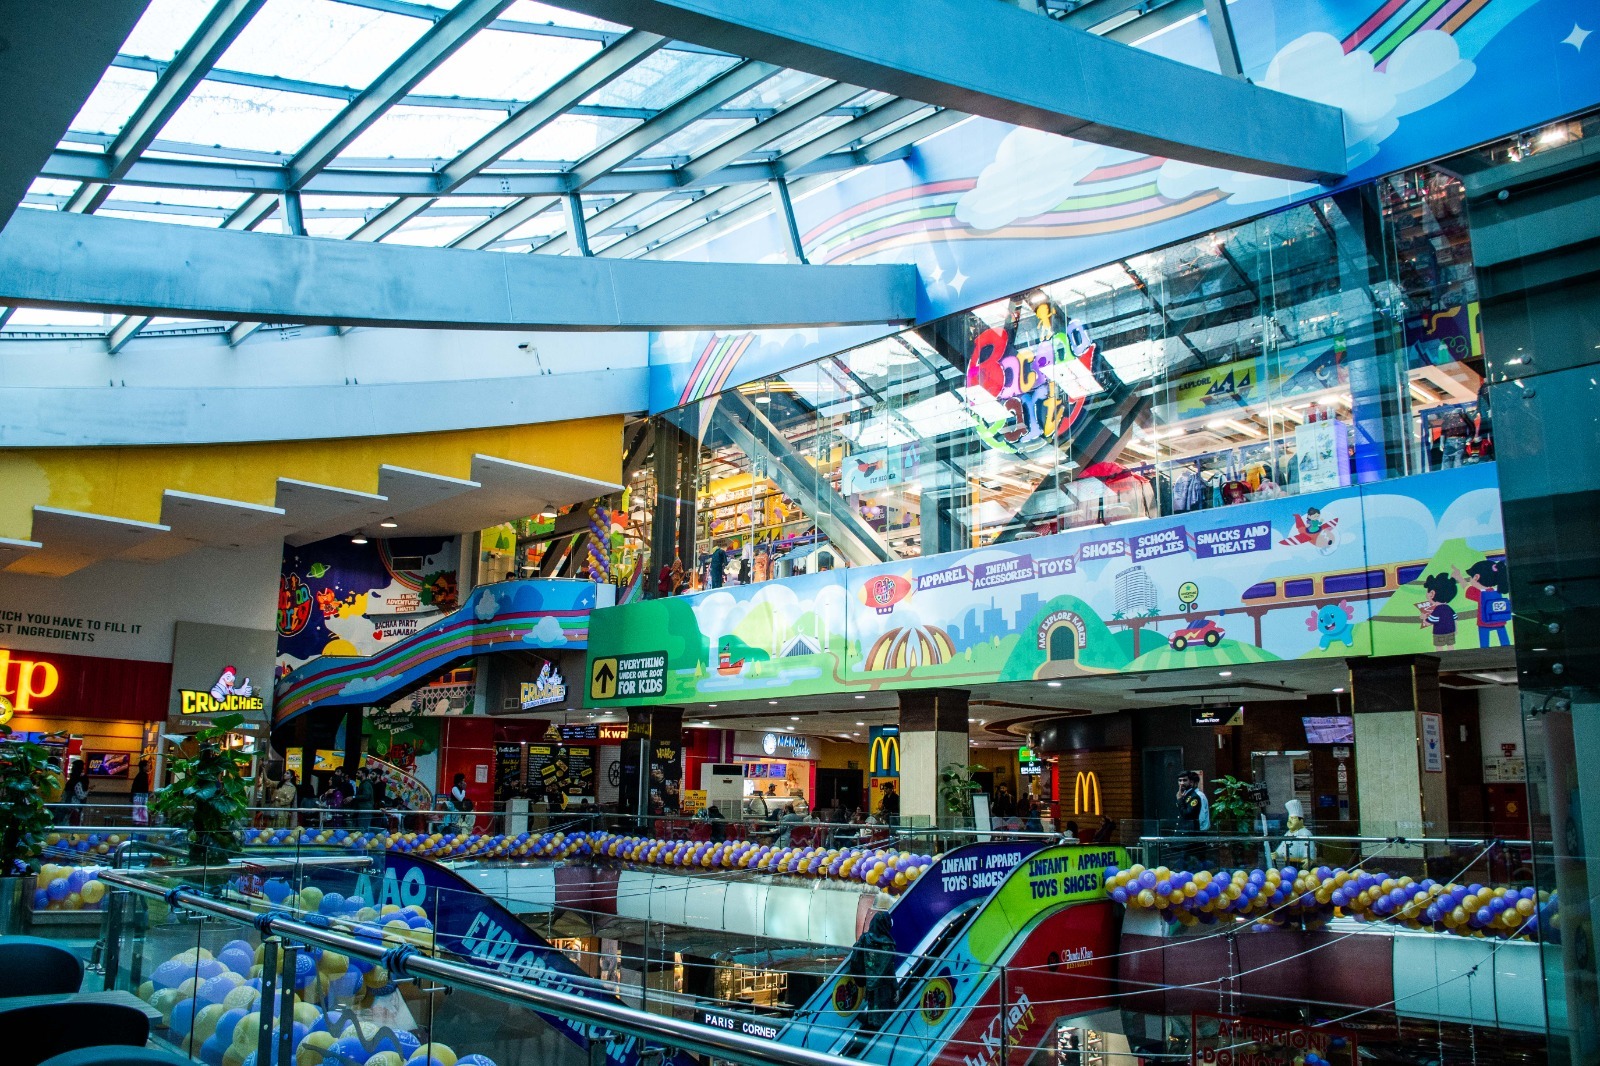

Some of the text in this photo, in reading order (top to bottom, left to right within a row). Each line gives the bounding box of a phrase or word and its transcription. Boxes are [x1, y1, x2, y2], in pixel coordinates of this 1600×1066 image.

[1179, 376, 1211, 391] EXPLORE
[1138, 530, 1180, 547] SCHOOL
[1197, 524, 1270, 545] SNACKS AND
[1082, 540, 1125, 558] SHOES
[1135, 541, 1185, 560] SUPPLIES
[1211, 539, 1256, 556] TREATS
[985, 559, 1020, 576] INFANT
[1039, 558, 1073, 575] TOYS
[919, 568, 966, 589] APPAREL
[974, 567, 1033, 589] ACCESSORIES
[27, 613, 50, 625] YOU
[52, 616, 84, 629] HAVE
[86, 620, 101, 630] TO
[104, 621, 127, 633] FILL
[131, 624, 142, 634] IT
[375, 619, 418, 630] BACHAA PARTY
[1041, 611, 1073, 631] EXPLORE
[17, 625, 95, 642] INGREDIENTS
[619, 656, 665, 671] EVERYTHING
[619, 669, 664, 680] UNDER ONE ROOF
[617, 678, 663, 695] FOR KIDS
[941, 856, 978, 874] INFANT
[1028, 851, 1119, 877] INFANT APPAREL
[353, 866, 427, 908] AAO
[941, 870, 1004, 893] TOYS SHOES
[1029, 878, 1058, 900] TOYS
[1063, 873, 1098, 895] SHOES
[1080, 946, 1094, 960] Khan
[705, 1013, 777, 1039] PARIS CORNER
[1218, 1021, 1329, 1053] ATTENTION!
[1203, 1046, 1234, 1065] DO
